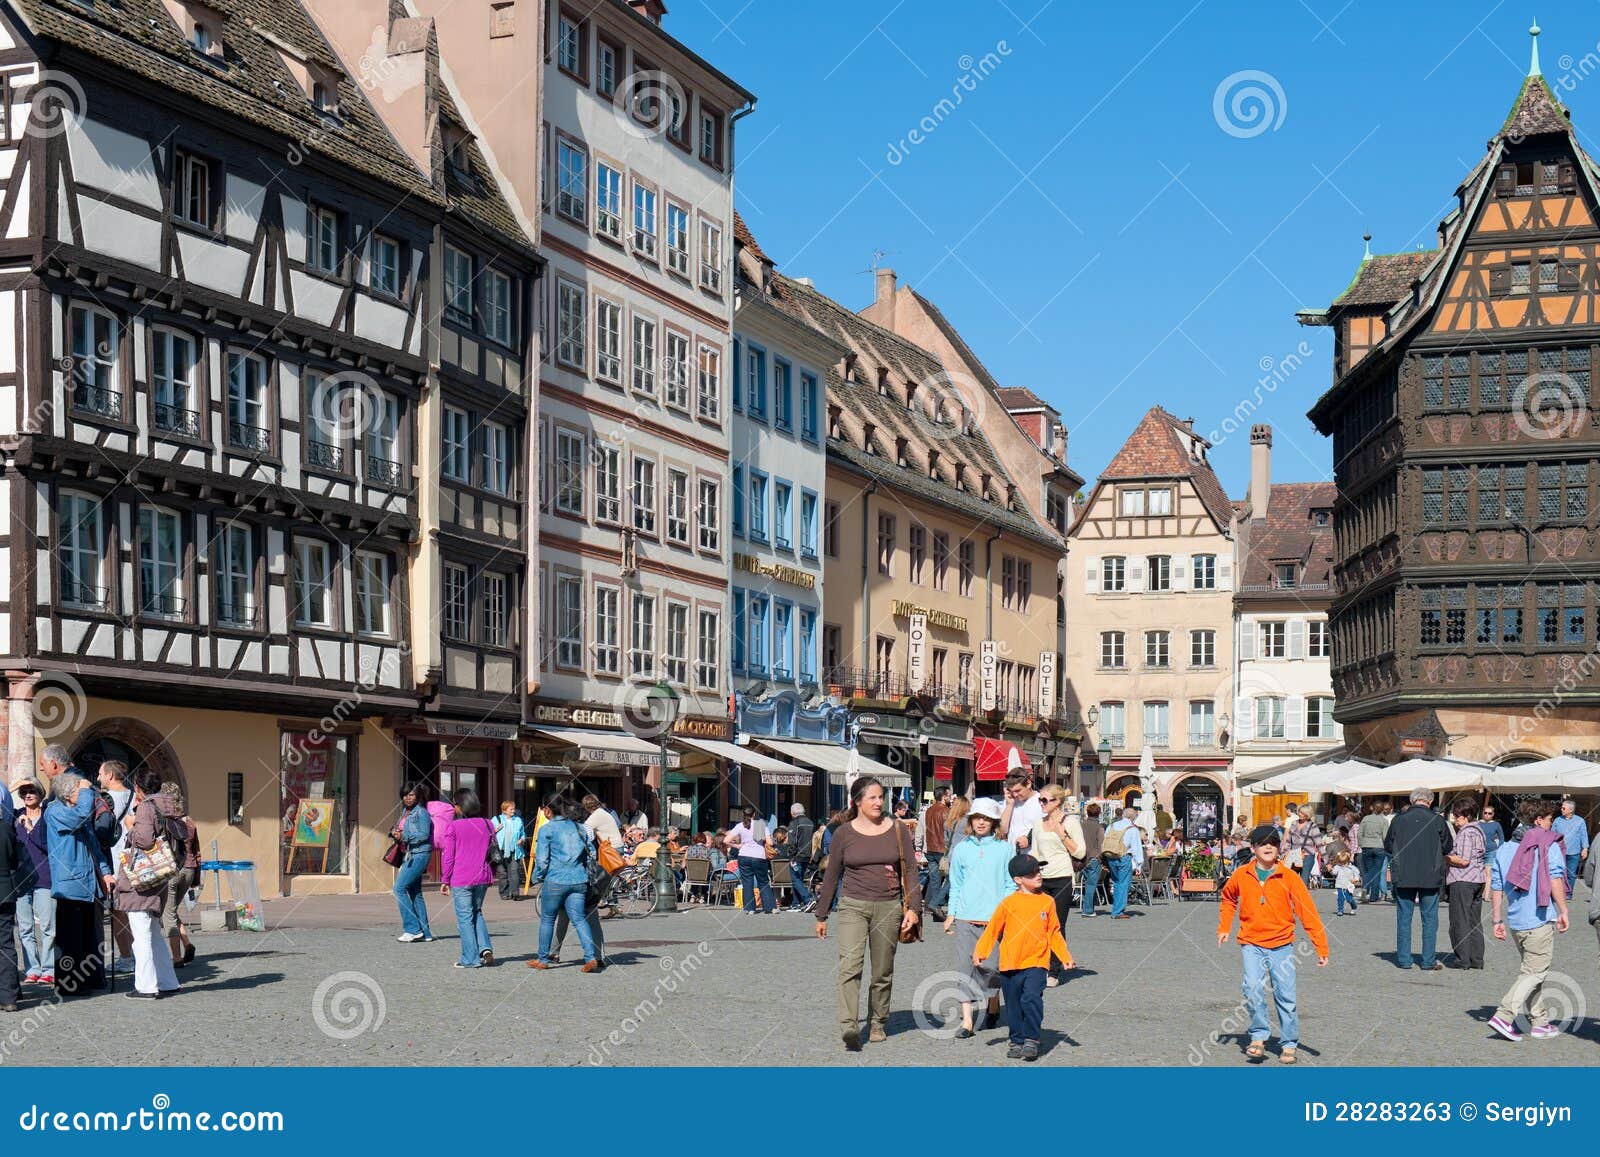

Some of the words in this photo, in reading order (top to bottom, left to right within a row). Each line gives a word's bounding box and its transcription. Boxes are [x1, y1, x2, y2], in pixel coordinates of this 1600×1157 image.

[911, 617, 923, 680] HOTEL
[983, 643, 994, 700] HOTEL
[1041, 654, 1052, 707] HOTEL
[859, 716, 877, 724] HOTEL
